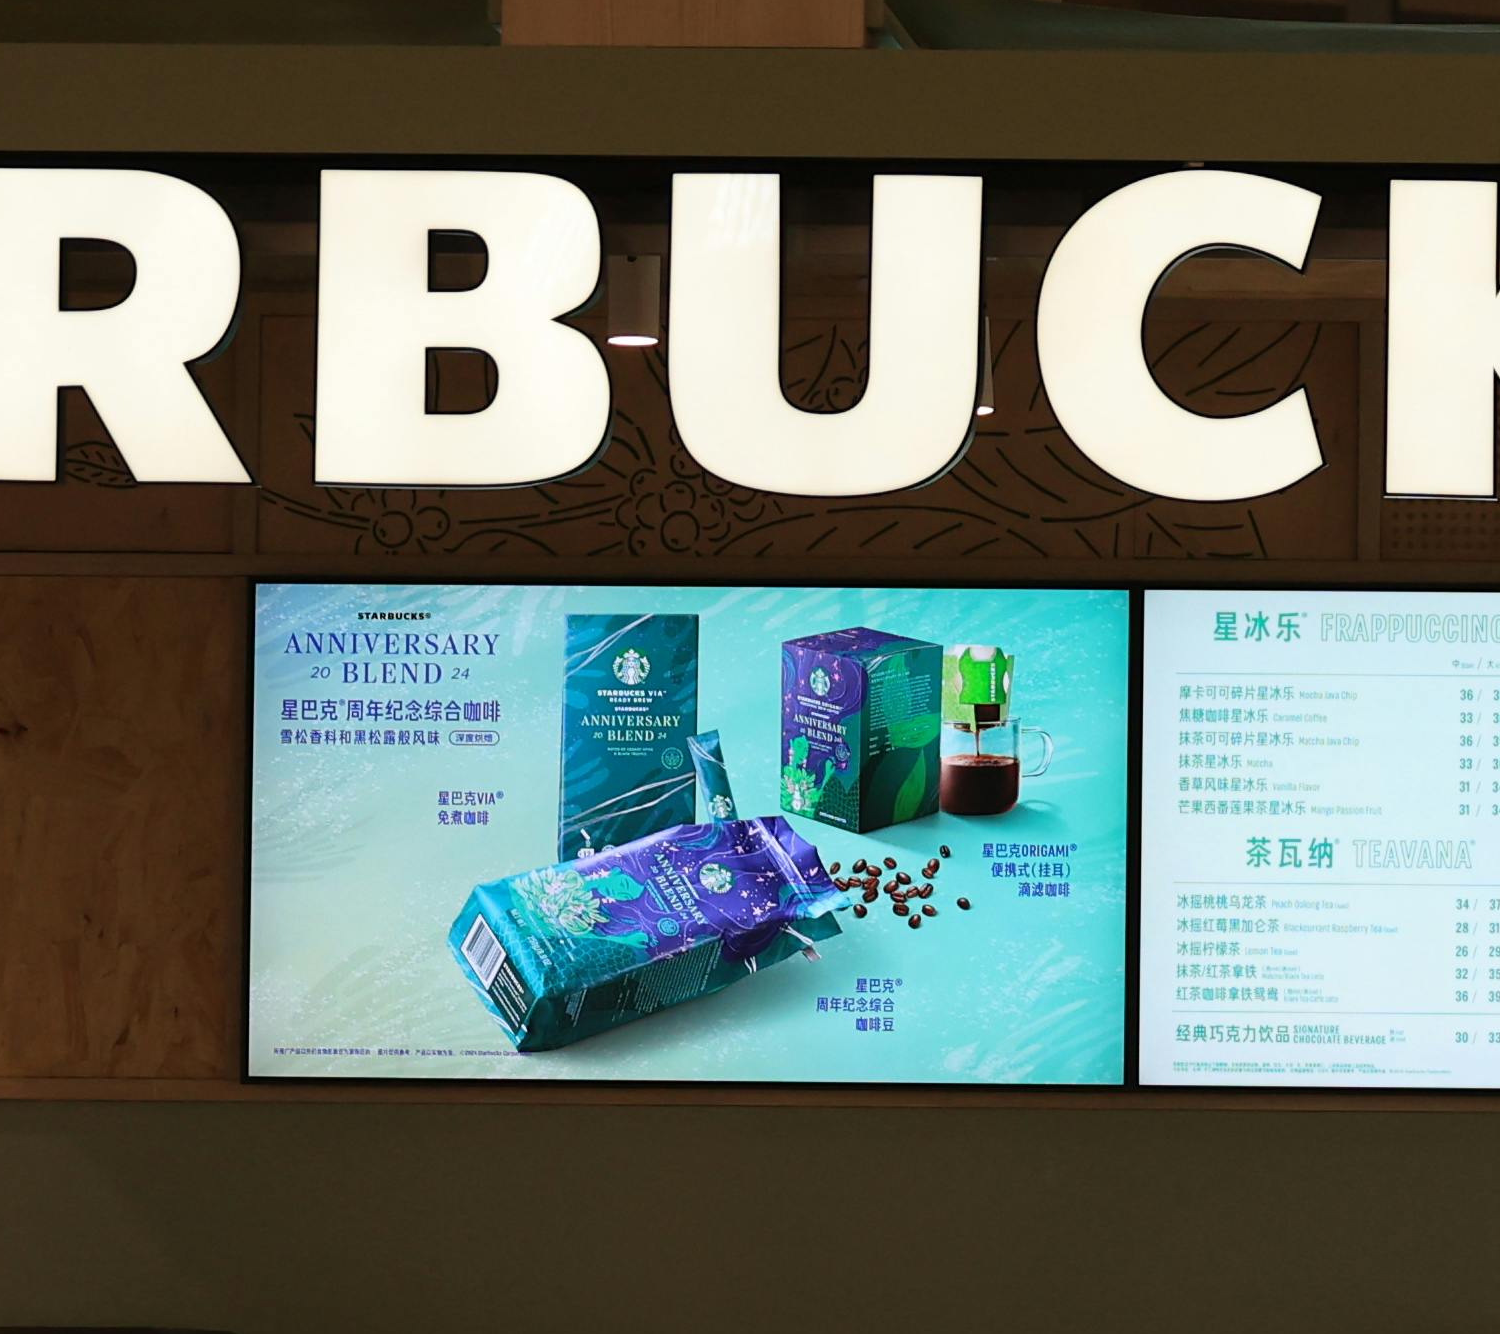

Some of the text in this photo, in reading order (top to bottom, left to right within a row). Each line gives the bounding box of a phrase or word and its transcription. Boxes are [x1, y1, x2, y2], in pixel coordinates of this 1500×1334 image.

[284, 633, 500, 656] ANNIVERSARY
[310, 662, 470, 684] 20 BLEND 24
[1179, 686, 1295, 701] 摩卡可可碎片星冰乐
[1460, 689, 1474, 701] 36
[581, 716, 681, 726] ANNIVERSARY
[794, 713, 847, 735] ANNIVERSARY
[1179, 709, 1269, 724] 焦糖咖啡星冰乐
[1460, 712, 1474, 724] 33
[280, 730, 440, 745] 雪松香料和黑松露般风味
[607, 730, 654, 741] BLEND
[808, 729, 833, 742] BLEND
[1178, 732, 1295, 747] 抹茶可可碎片星冰乐
[1178, 755, 1242, 770] 抹茶星冰乐
[1178, 777, 1268, 793] 香草风味星冰乐
[438, 811, 488, 825] 免煮咖啡
[654, 853, 708, 925] ANNIVERSARY
[1018, 883, 1070, 899] 滴滤咖啡
[1177, 894, 1267, 910] 冰摇桃桃乌龙茶
[1177, 918, 1279, 933] 冰摇红莓黑加仑茶
[1177, 941, 1241, 956] 冰摇柠檬茶
[1176, 964, 1257, 979] 抹茶/红茶拿铁
[817, 997, 894, 1014] 周年纪念综合
[856, 1017, 894, 1033] 咖啡豆
[1176, 1025, 1290, 1043] 经典巧克力饮品
